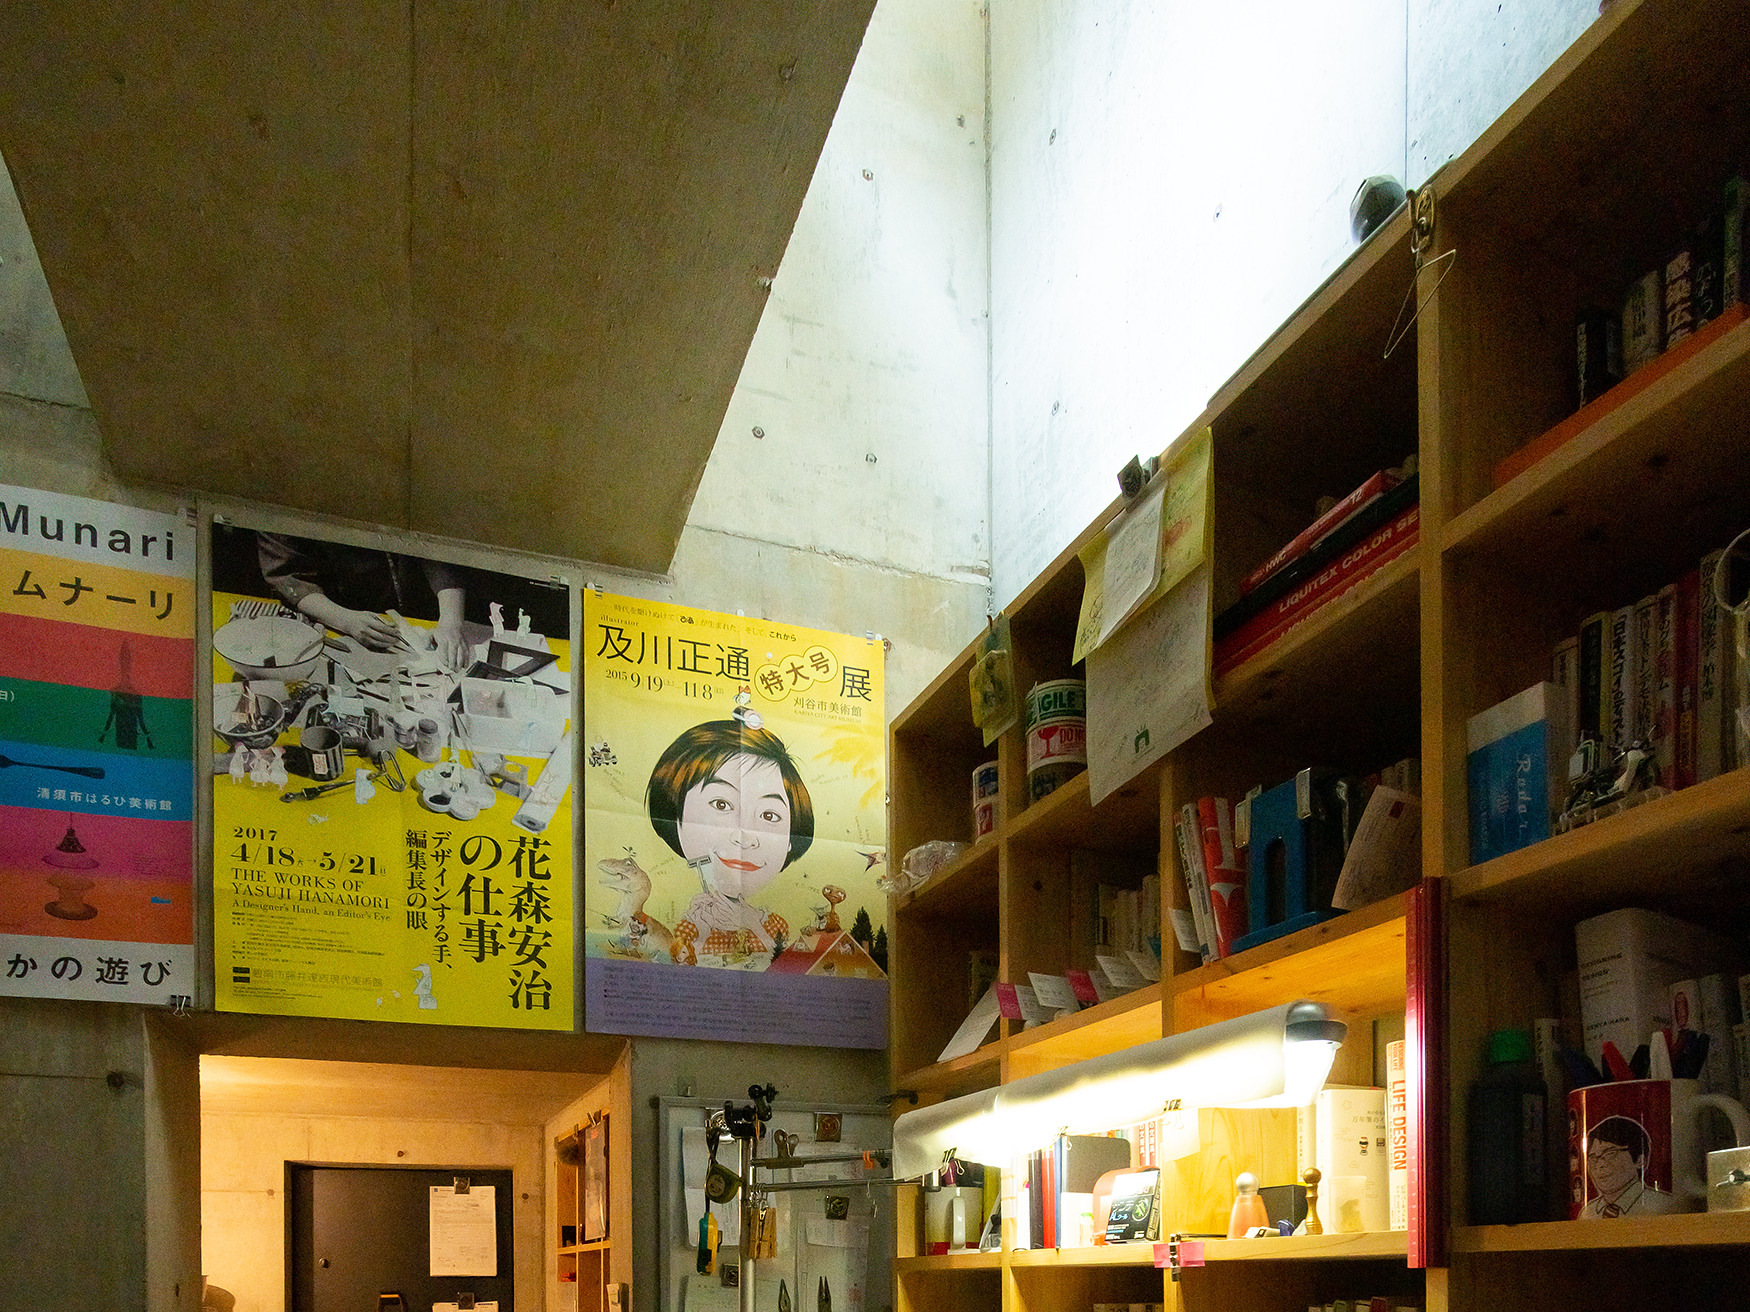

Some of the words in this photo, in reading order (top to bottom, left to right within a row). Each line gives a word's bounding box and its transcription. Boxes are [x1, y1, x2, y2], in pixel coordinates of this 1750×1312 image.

[0, 501, 174, 561] Munari
[1278, 565, 1339, 613] LIQUITEX
[1341, 529, 1393, 570] COLOR
[1396, 508, 1420, 533] SE
[12, 569, 174, 620] ムナーリ
[596, 623, 751, 683] 及川正通
[604, 668, 628, 681] 2015
[758, 650, 832, 695] 特大号
[839, 665, 873, 703] 展
[1037, 690, 1079, 712] GILE
[36, 786, 173, 812] 清須市はるひ美術館
[233, 826, 278, 842] 2017
[231, 867, 267, 883] THE
[274, 872, 336, 890] WORKS
[342, 879, 364, 893] OF
[231, 882, 292, 901] YASUJI
[299, 889, 390, 910] HANAMORI
[405, 829, 429, 931] 編集長の眼
[456, 834, 506, 964] の仕事
[232, 900, 240, 908] A
[242, 900, 289, 913] Designer's
[337, 909, 372, 919] Editor's
[507, 835, 554, 1011] 花森安治
[6, 951, 173, 987] かの遊び
[1391, 1079, 1407, 1114] LIFE
[1392, 1116, 1407, 1171] DESIGN
